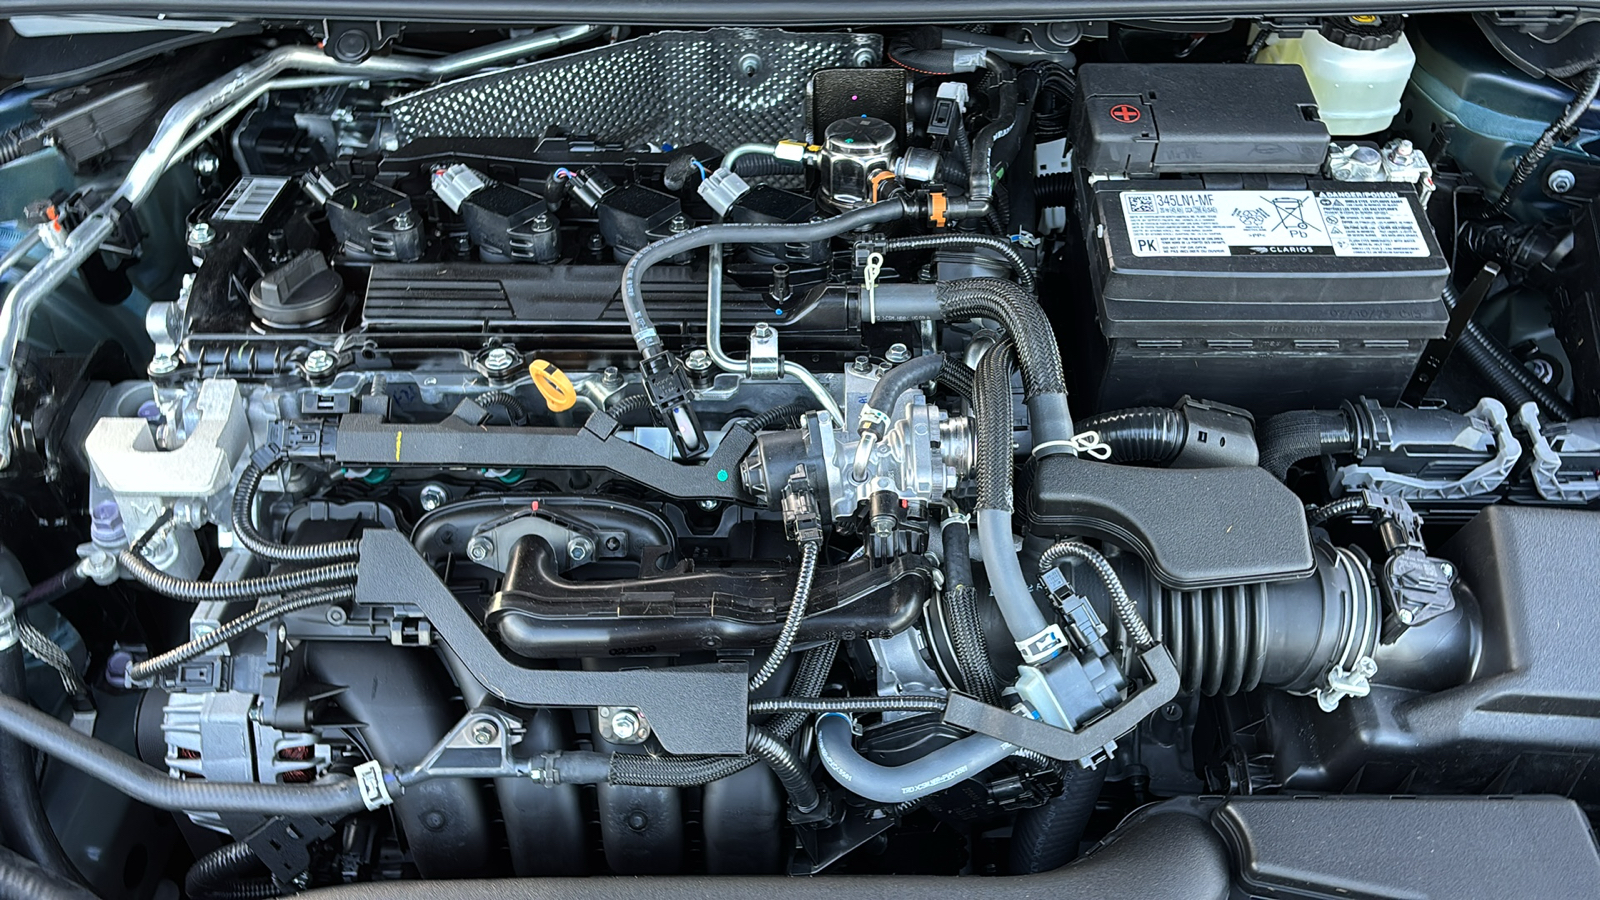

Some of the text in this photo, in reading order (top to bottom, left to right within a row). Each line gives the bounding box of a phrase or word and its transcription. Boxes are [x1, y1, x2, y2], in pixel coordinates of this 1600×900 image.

[1157, 194, 1214, 206] 345LN1-MF
[1289, 230, 1308, 238] Pb
[1138, 240, 1157, 251] PK
